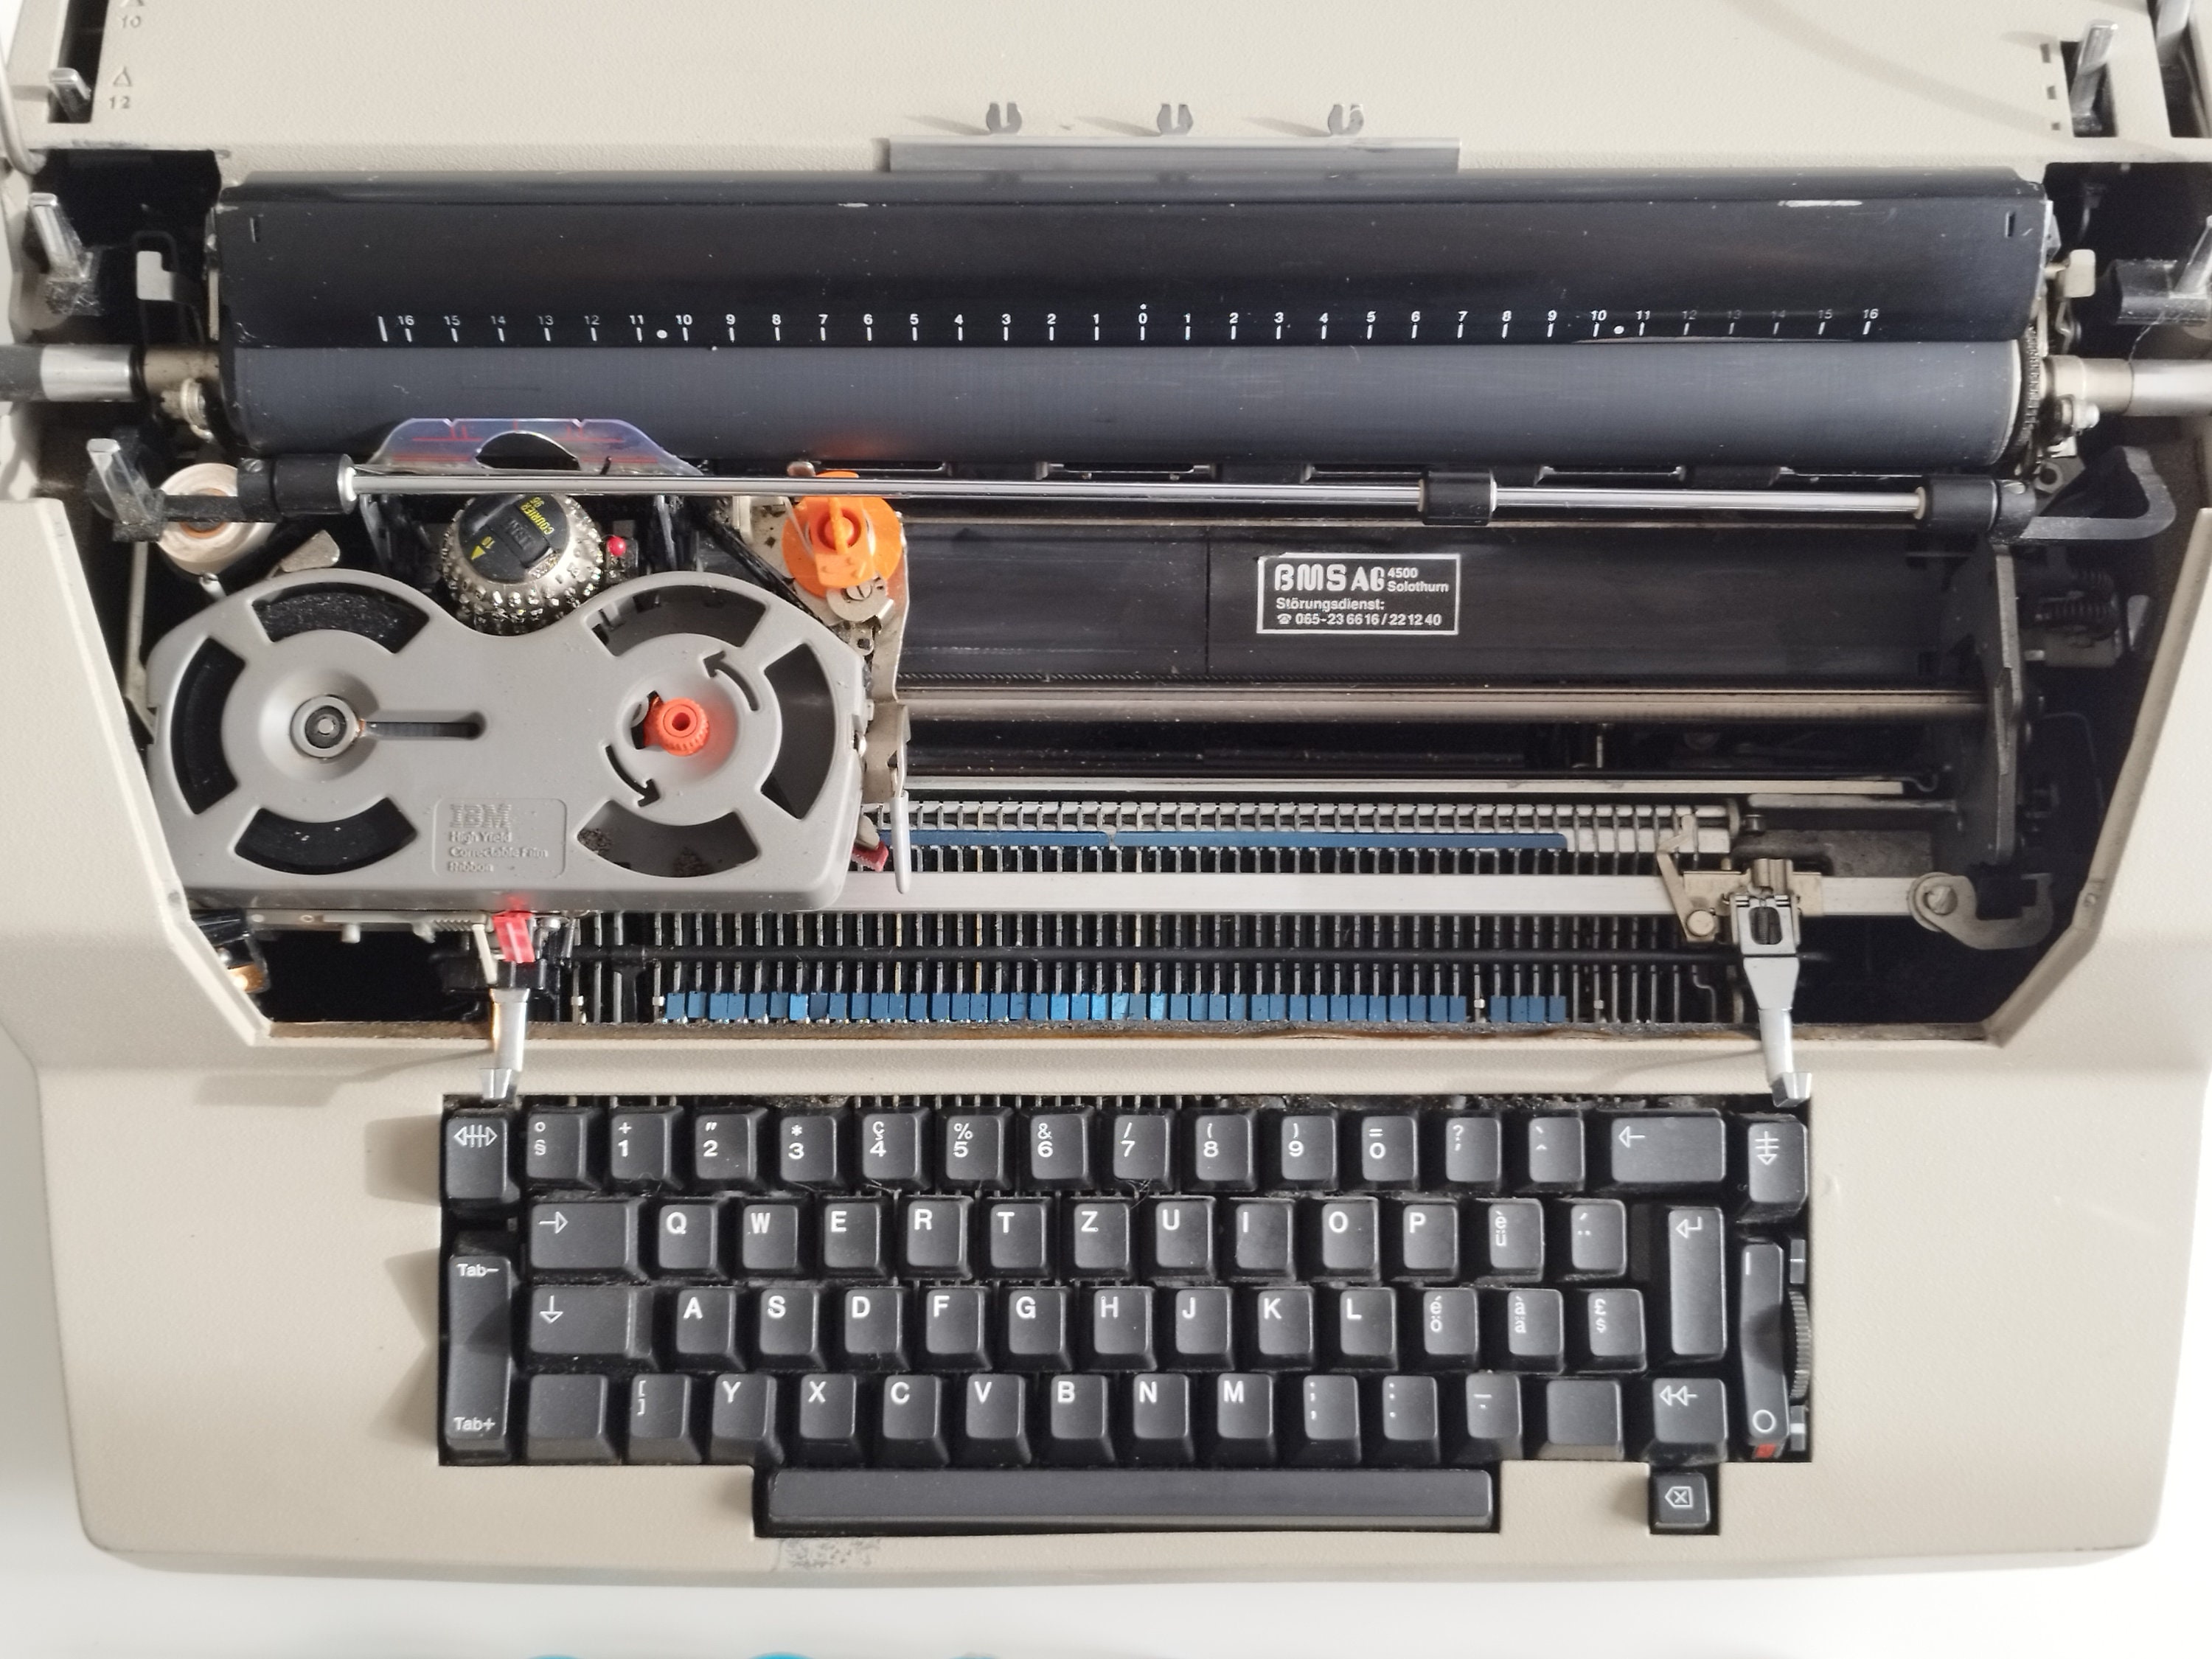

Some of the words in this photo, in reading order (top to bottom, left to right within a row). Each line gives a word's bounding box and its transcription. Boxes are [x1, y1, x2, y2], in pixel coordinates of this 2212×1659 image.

[120, 15, 142, 29] 10
[108, 95, 131, 110] 12
[398, 315, 414, 326] 16
[443, 315, 461, 326] 15
[490, 316, 506, 324] 14
[538, 315, 554, 326] 13
[584, 315, 599, 325] 12
[629, 314, 644, 325] 11
[675, 314, 692, 325] 10
[726, 313, 736, 325] 9
[772, 313, 782, 325] 8
[818, 313, 829, 324] 7
[863, 313, 873, 325] 6
[910, 313, 919, 325] 5
[954, 314, 964, 325] 4
[1001, 313, 1012, 325] 3
[1047, 313, 1057, 325] 2
[1093, 313, 1099, 324] 1
[1138, 312, 1148, 324] 0
[1183, 313, 1191, 324] 1
[1229, 312, 1239, 324] 2
[1273, 311, 1284, 324] 3
[1319, 312, 1329, 324] 4
[1366, 310, 1376, 323] 5
[1411, 310, 1420, 322] 6
[1458, 310, 1468, 322] 7
[1502, 310, 1512, 322] 8
[1548, 310, 1557, 321] 9
[1590, 310, 1607, 321] 10
[1635, 310, 1651, 320] 11
[1682, 310, 1697, 320] 12
[1818, 309, 1832, 319] 15
[1864, 308, 1879, 319] 16
[521, 502, 554, 535] COURIER
[481, 535, 495, 549] 10
[1274, 563, 1347, 591] BMS
[1351, 566, 1385, 591] AG
[1387, 567, 1419, 579] 4500
[1387, 580, 1449, 593] Solothurn
[1276, 597, 1385, 613] Störungsdienst:
[449, 803, 512, 829] IBM
[448, 831, 479, 845] High
[480, 830, 512, 842] Yield
[520, 846, 549, 858] Film
[447, 860, 495, 872] Ribbon
[953, 1123, 973, 1140] %
[1037, 1122, 1052, 1140] &
[1453, 1124, 1464, 1141] ?
[534, 1139, 546, 1156] §
[618, 1139, 628, 1158] 1
[703, 1139, 718, 1157] 2
[788, 1142, 804, 1160] 3
[869, 1140, 886, 1158] 4
[953, 1141, 968, 1158] 5
[1037, 1140, 1053, 1158] 6
[1120, 1140, 1135, 1158] 7
[1203, 1141, 1219, 1158] 8
[1288, 1140, 1304, 1157] 9
[666, 1211, 686, 1234] Q
[751, 1212, 771, 1234] W
[830, 1210, 847, 1233] E
[914, 1208, 933, 1231] R
[995, 1211, 1015, 1234] T
[1081, 1211, 1099, 1232] Z
[1162, 1208, 1180, 1231] U
[1242, 1211, 1248, 1233] I
[1328, 1211, 1348, 1234] O
[1409, 1211, 1426, 1234] P
[1495, 1210, 1507, 1230] è
[1495, 1229, 1506, 1247] ü
[683, 1296, 703, 1319] A
[768, 1295, 785, 1318] S
[852, 1295, 870, 1318] D
[933, 1295, 950, 1318] F
[1015, 1295, 1036, 1319] G
[1101, 1295, 1119, 1318] H
[1182, 1297, 1196, 1319] J
[1264, 1298, 1281, 1319] K
[1346, 1298, 1362, 1320] L
[1430, 1295, 1442, 1315] é
[1514, 1295, 1526, 1315] à
[1594, 1298, 1607, 1315] £
[1430, 1315, 1442, 1332] ö
[1596, 1317, 1607, 1333] $
[722, 1380, 742, 1403] Y
[808, 1381, 827, 1403] X
[890, 1381, 910, 1405] C
[974, 1381, 992, 1403] V
[1057, 1380, 1075, 1402] B
[1139, 1381, 1157, 1402] N
[1223, 1380, 1244, 1402] M
[453, 1416, 495, 1431] Tab+
